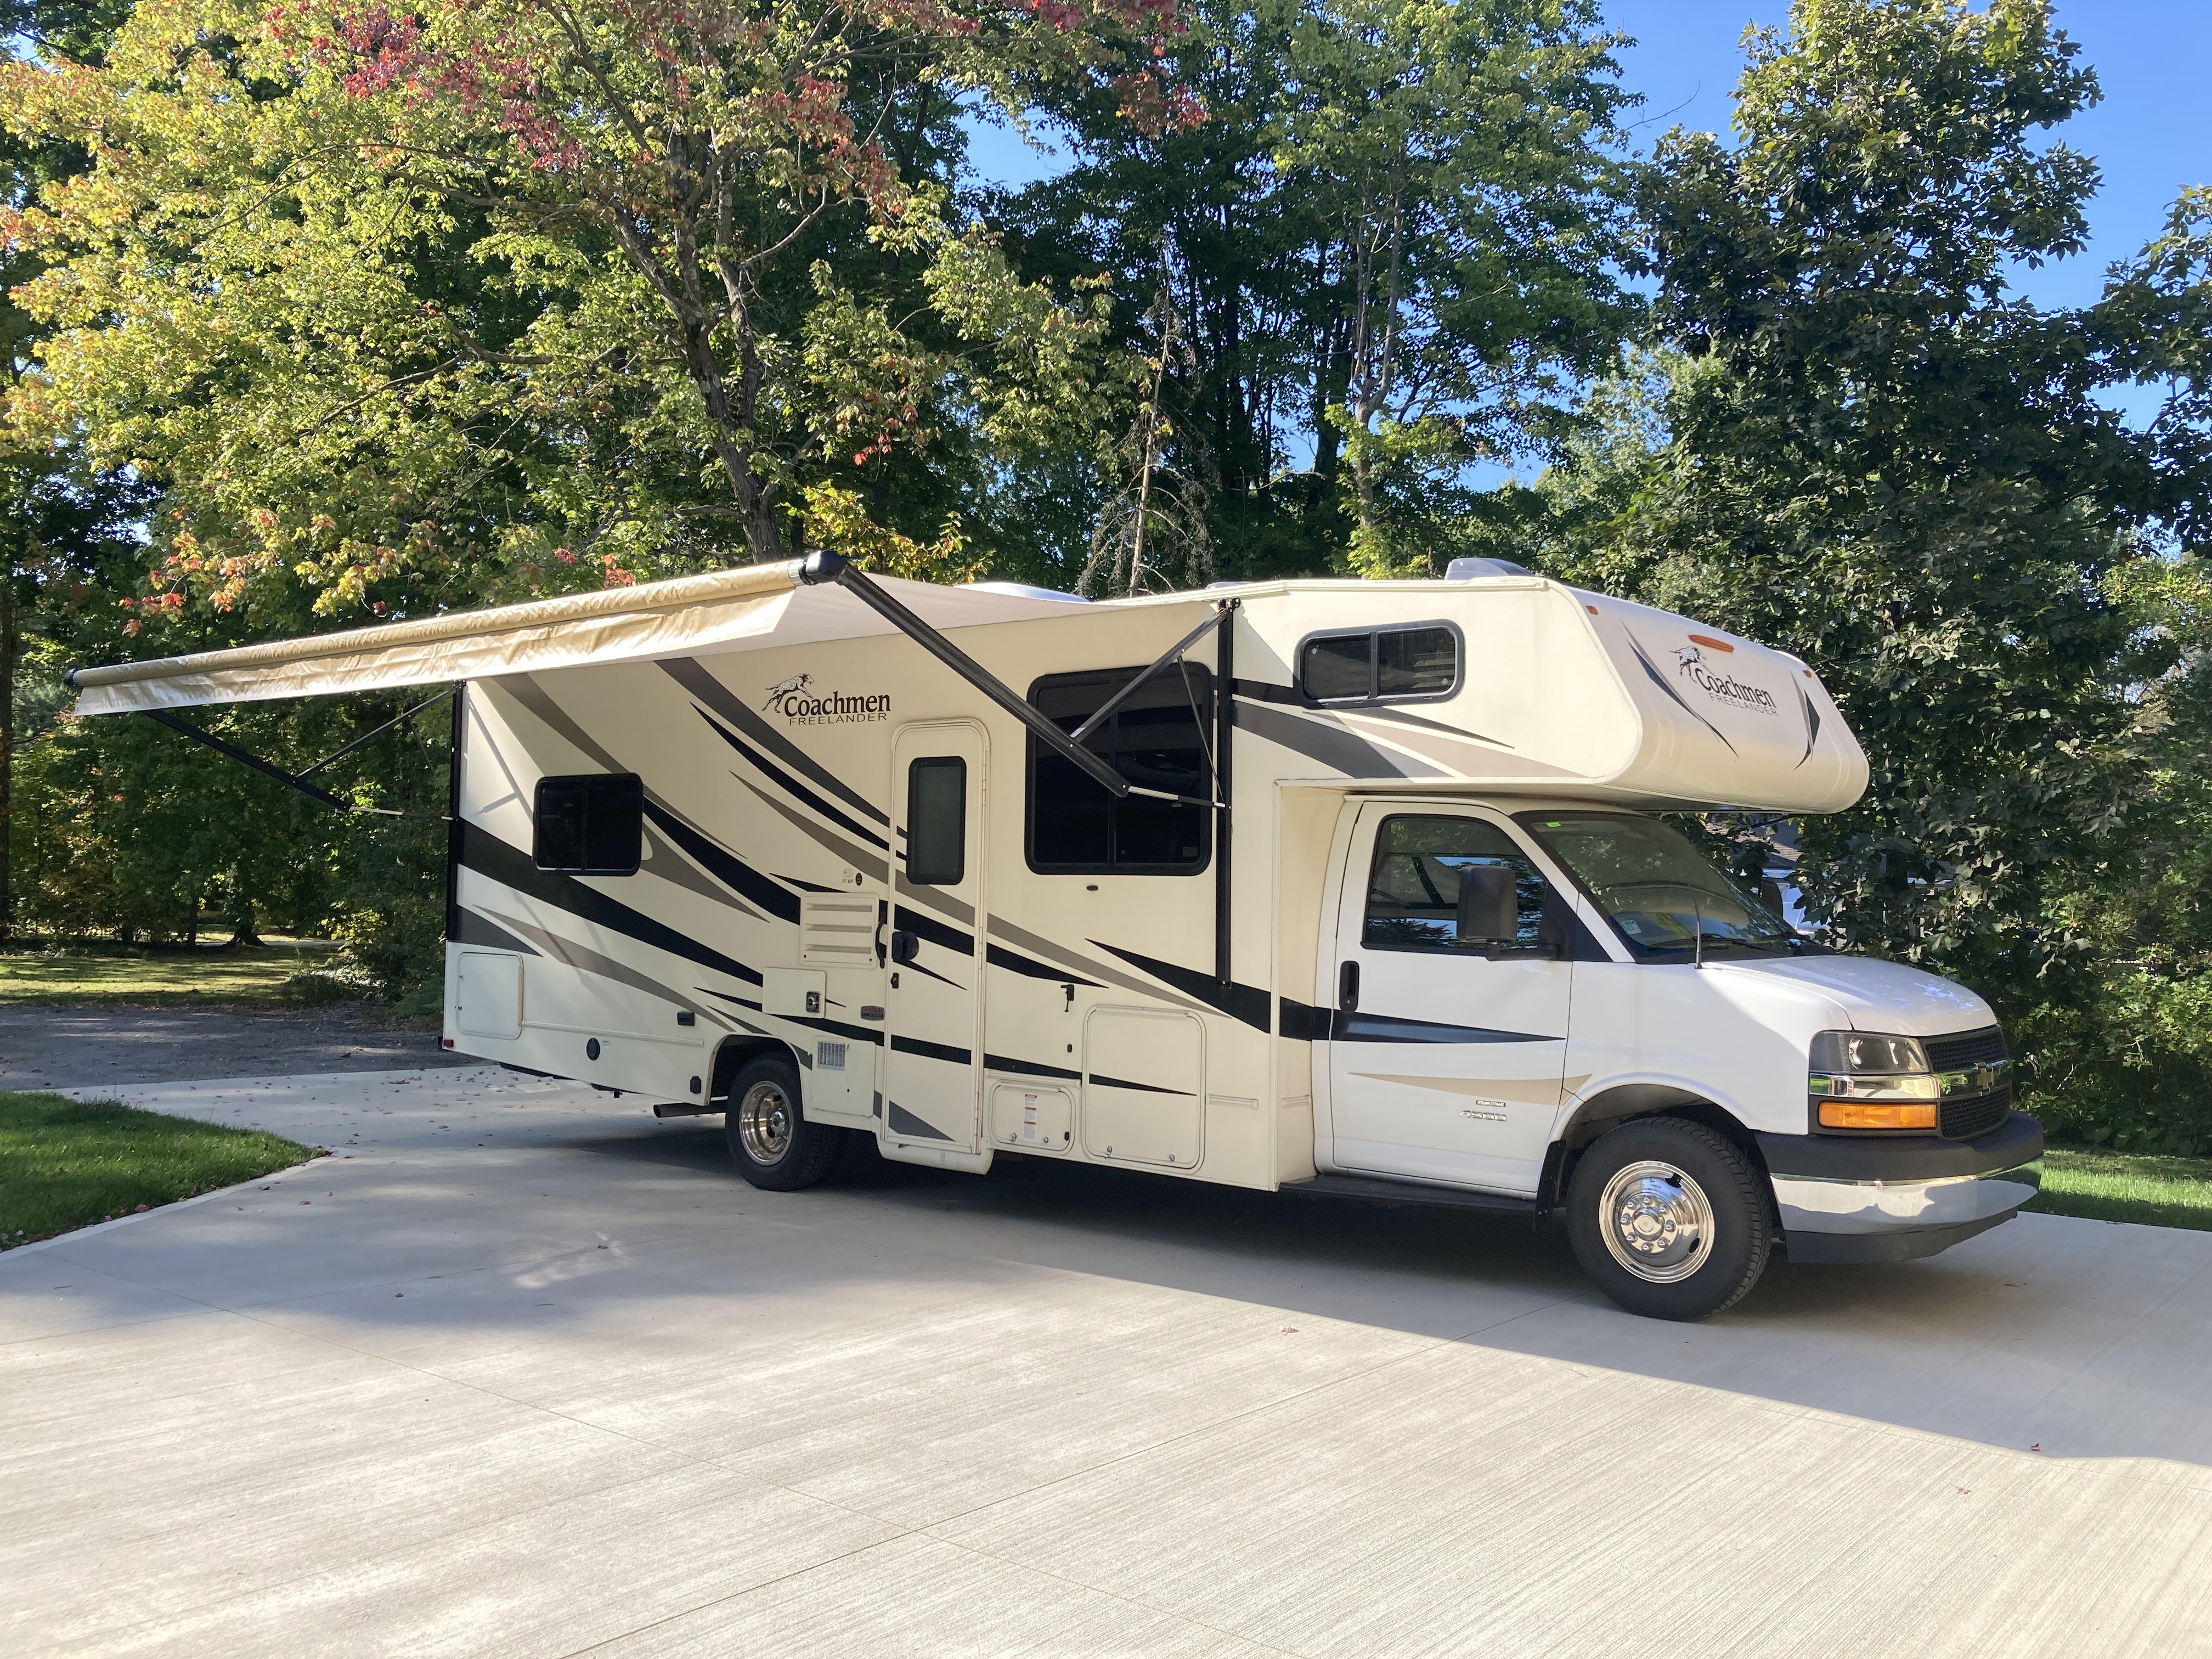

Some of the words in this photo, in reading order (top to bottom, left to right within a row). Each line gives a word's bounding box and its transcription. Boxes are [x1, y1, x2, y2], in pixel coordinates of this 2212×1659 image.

[1695, 668, 1778, 708] Coachmen
[784, 691, 891, 717] Coachmen
[1709, 692, 1779, 716] FREELANDER
[789, 713, 887, 726] FREELANDER
[1459, 1110, 1507, 1121] 4500
